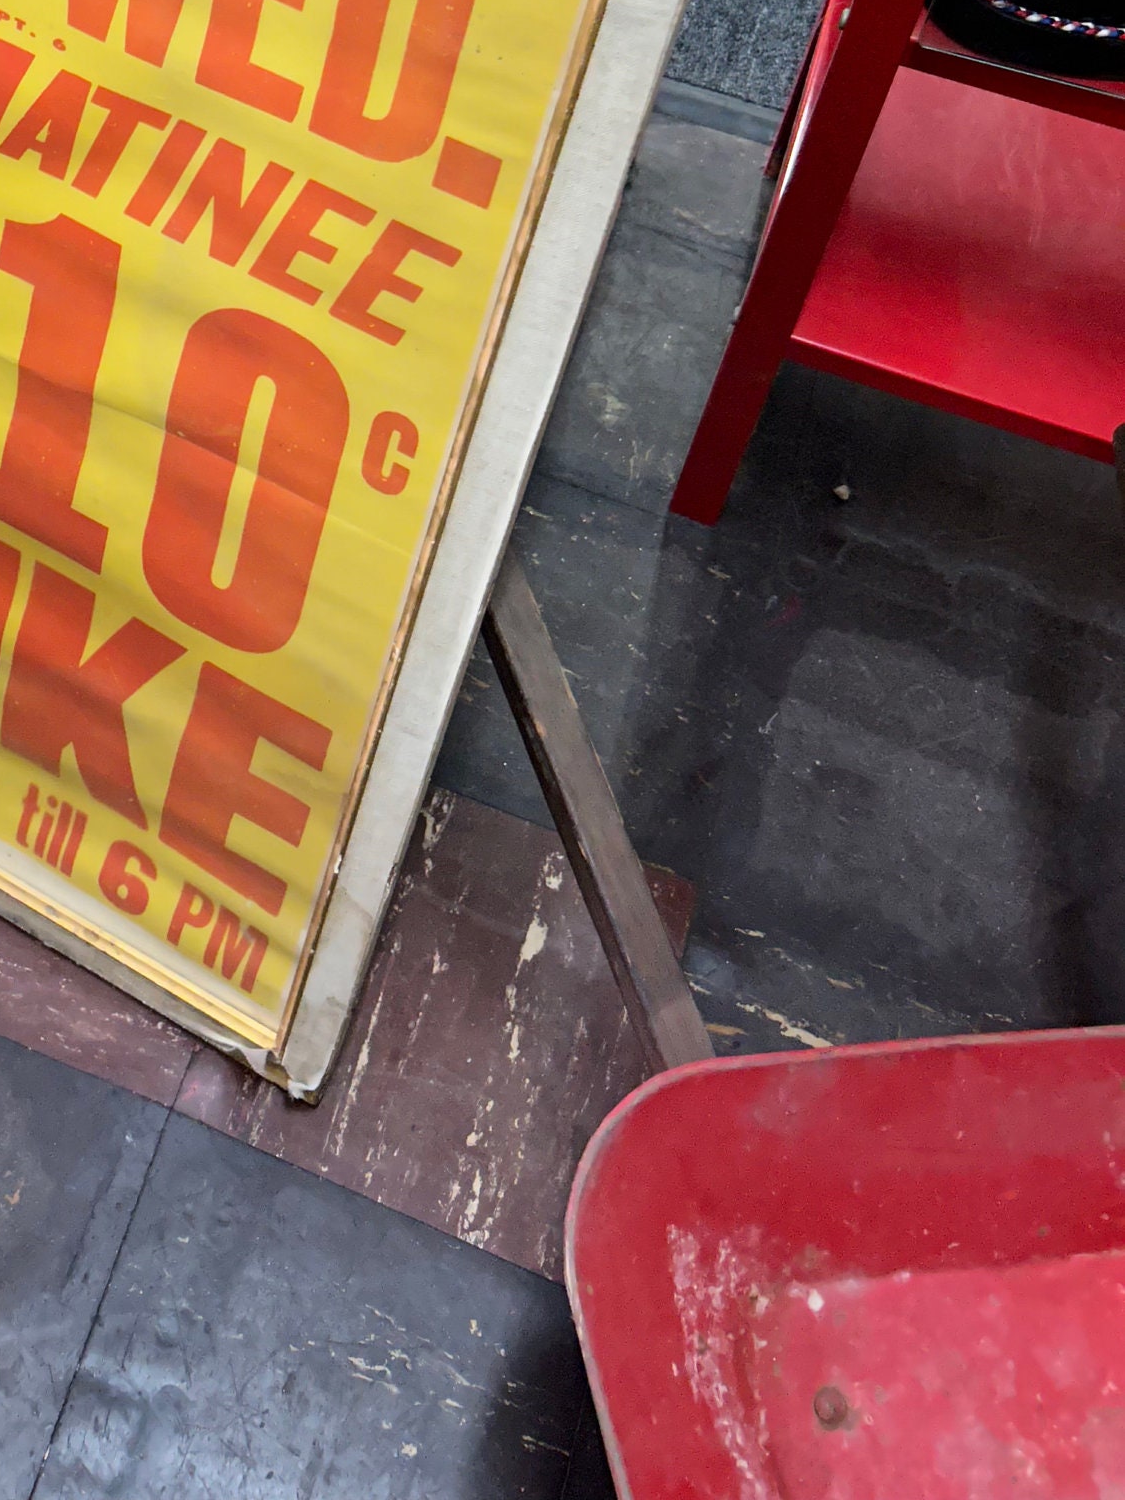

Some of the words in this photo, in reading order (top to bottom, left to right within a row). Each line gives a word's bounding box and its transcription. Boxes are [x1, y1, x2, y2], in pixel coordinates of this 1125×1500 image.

[52, 38, 67, 52] 6
[16, 784, 88, 878] till
[97, 840, 157, 916] 6
[166, 883, 269, 994] PM
